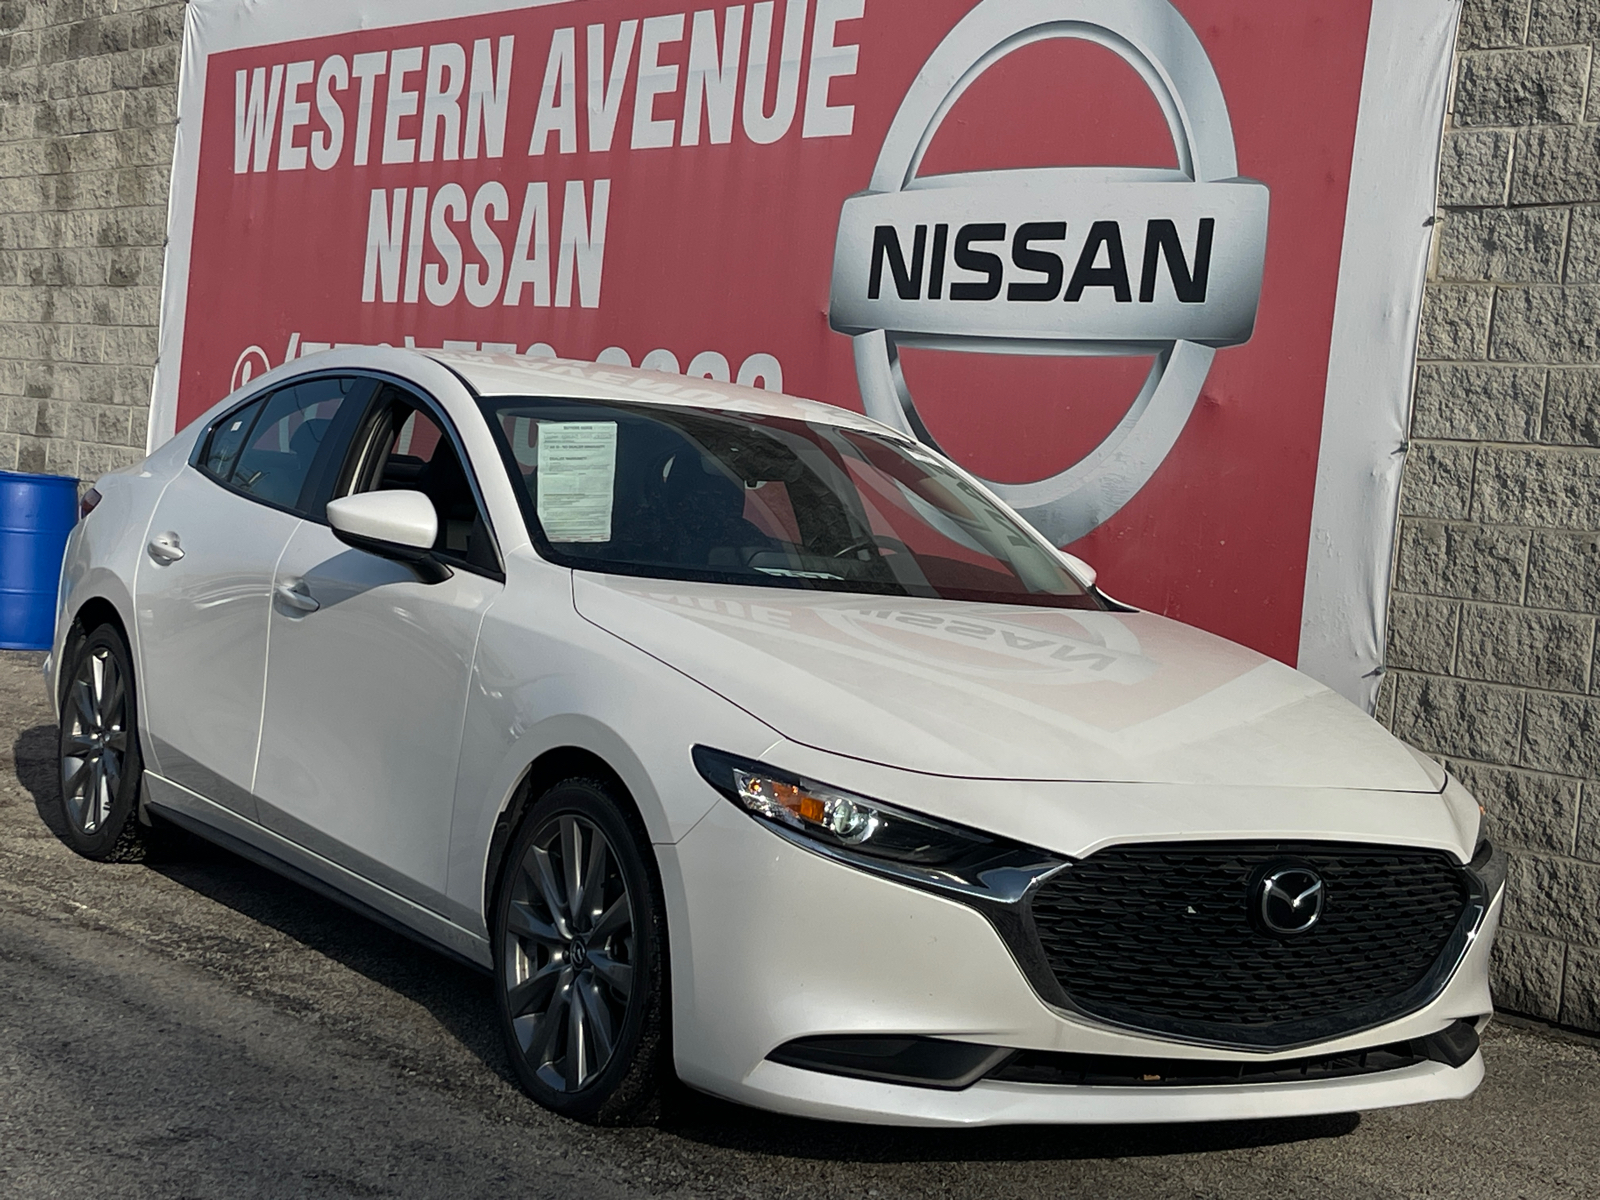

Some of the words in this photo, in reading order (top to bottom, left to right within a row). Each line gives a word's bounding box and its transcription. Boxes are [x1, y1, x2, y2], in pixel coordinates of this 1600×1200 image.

[234, 35, 515, 174] WESTERN
[529, 0, 867, 156] AVENUE
[361, 178, 611, 309] NISSAN
[867, 217, 1215, 303] NISSAN
